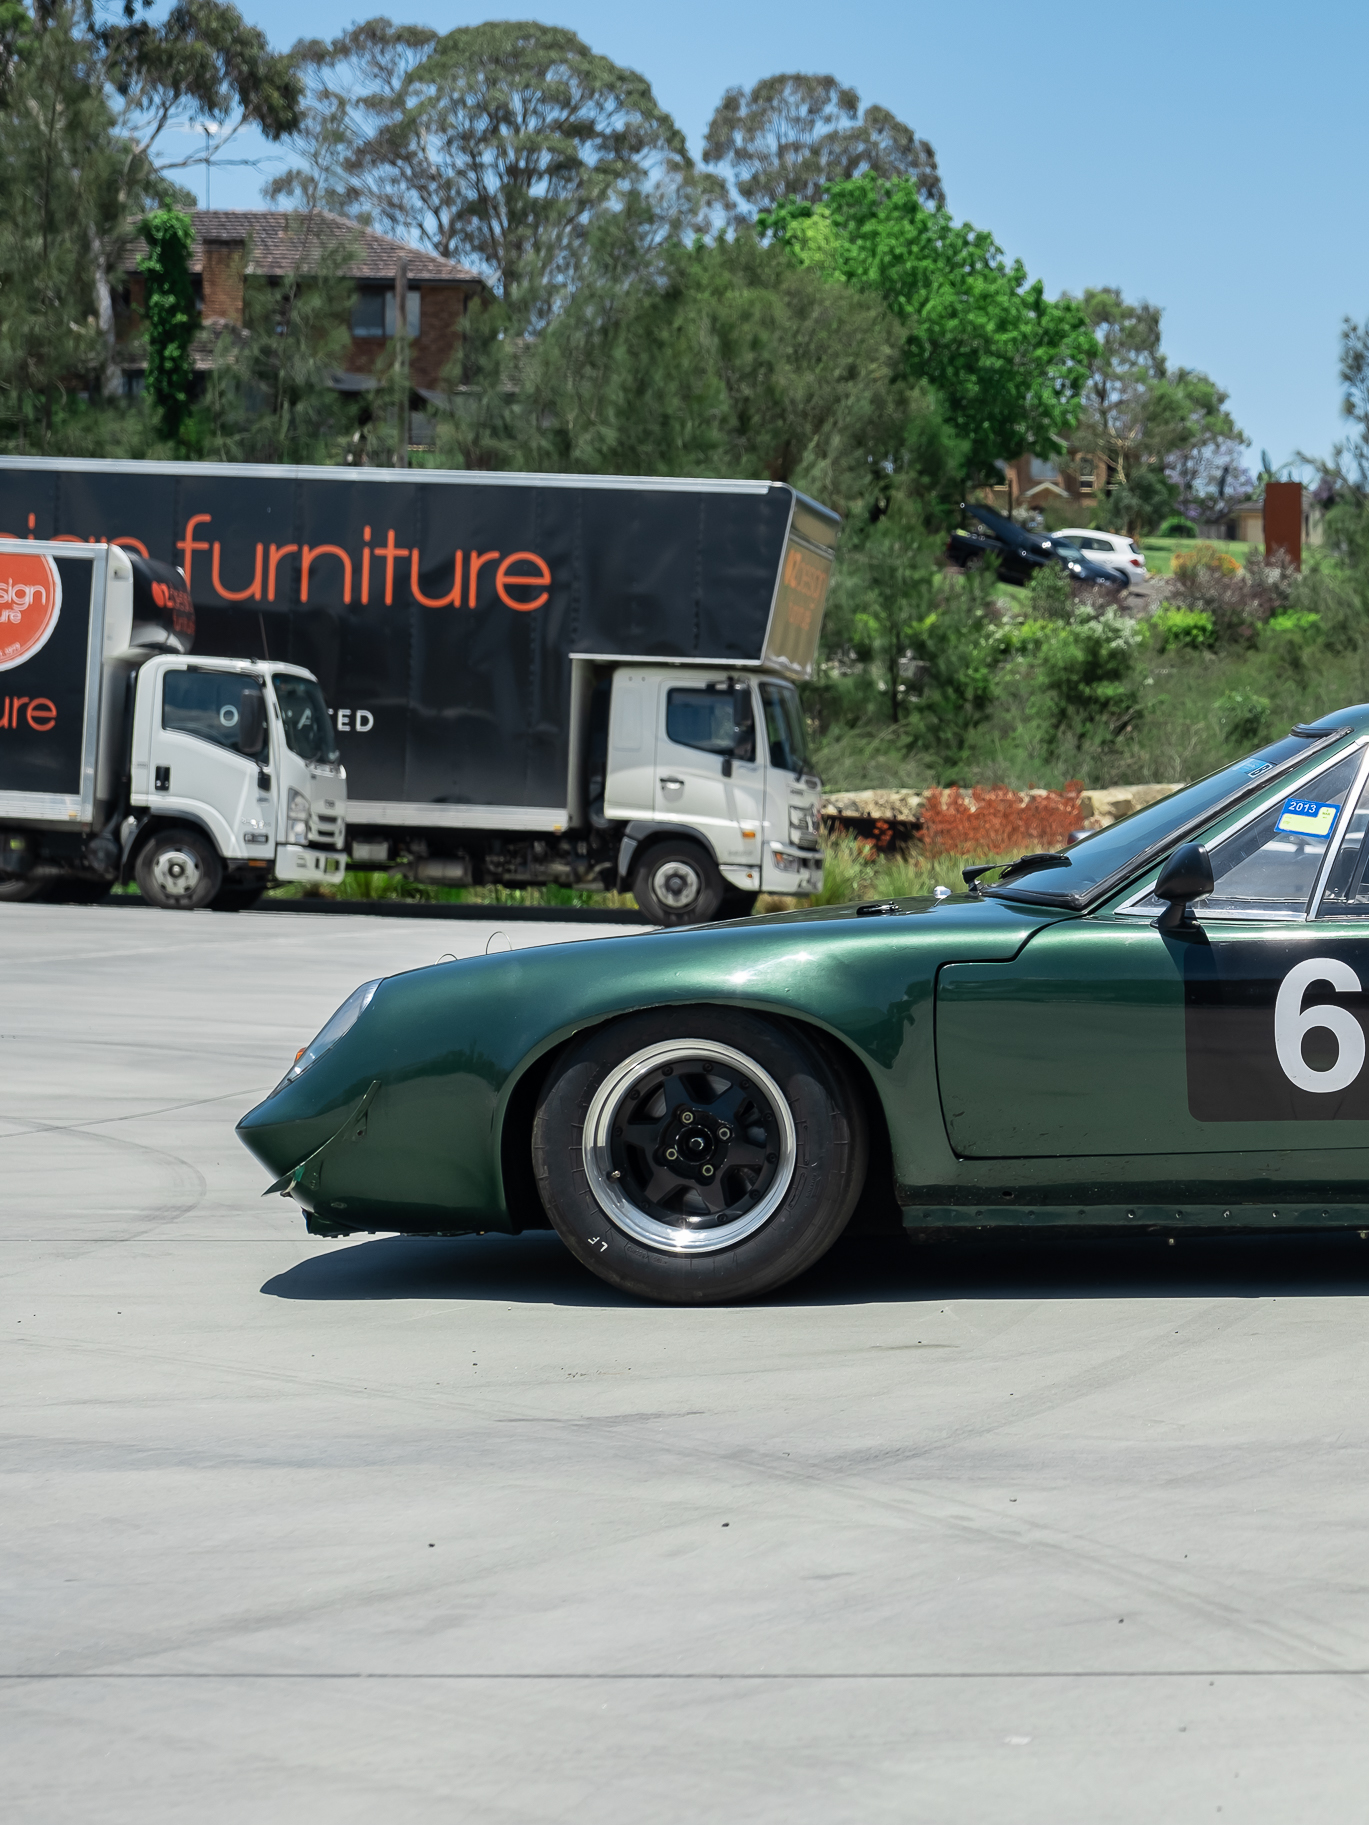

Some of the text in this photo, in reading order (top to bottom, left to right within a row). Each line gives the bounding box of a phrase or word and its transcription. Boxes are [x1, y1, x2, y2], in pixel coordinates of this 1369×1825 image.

[176, 513, 551, 612] furniture
[1288, 801, 1317, 813] 2013
[1275, 957, 1365, 1093] 6
[587, 1236, 608, 1252] LF
